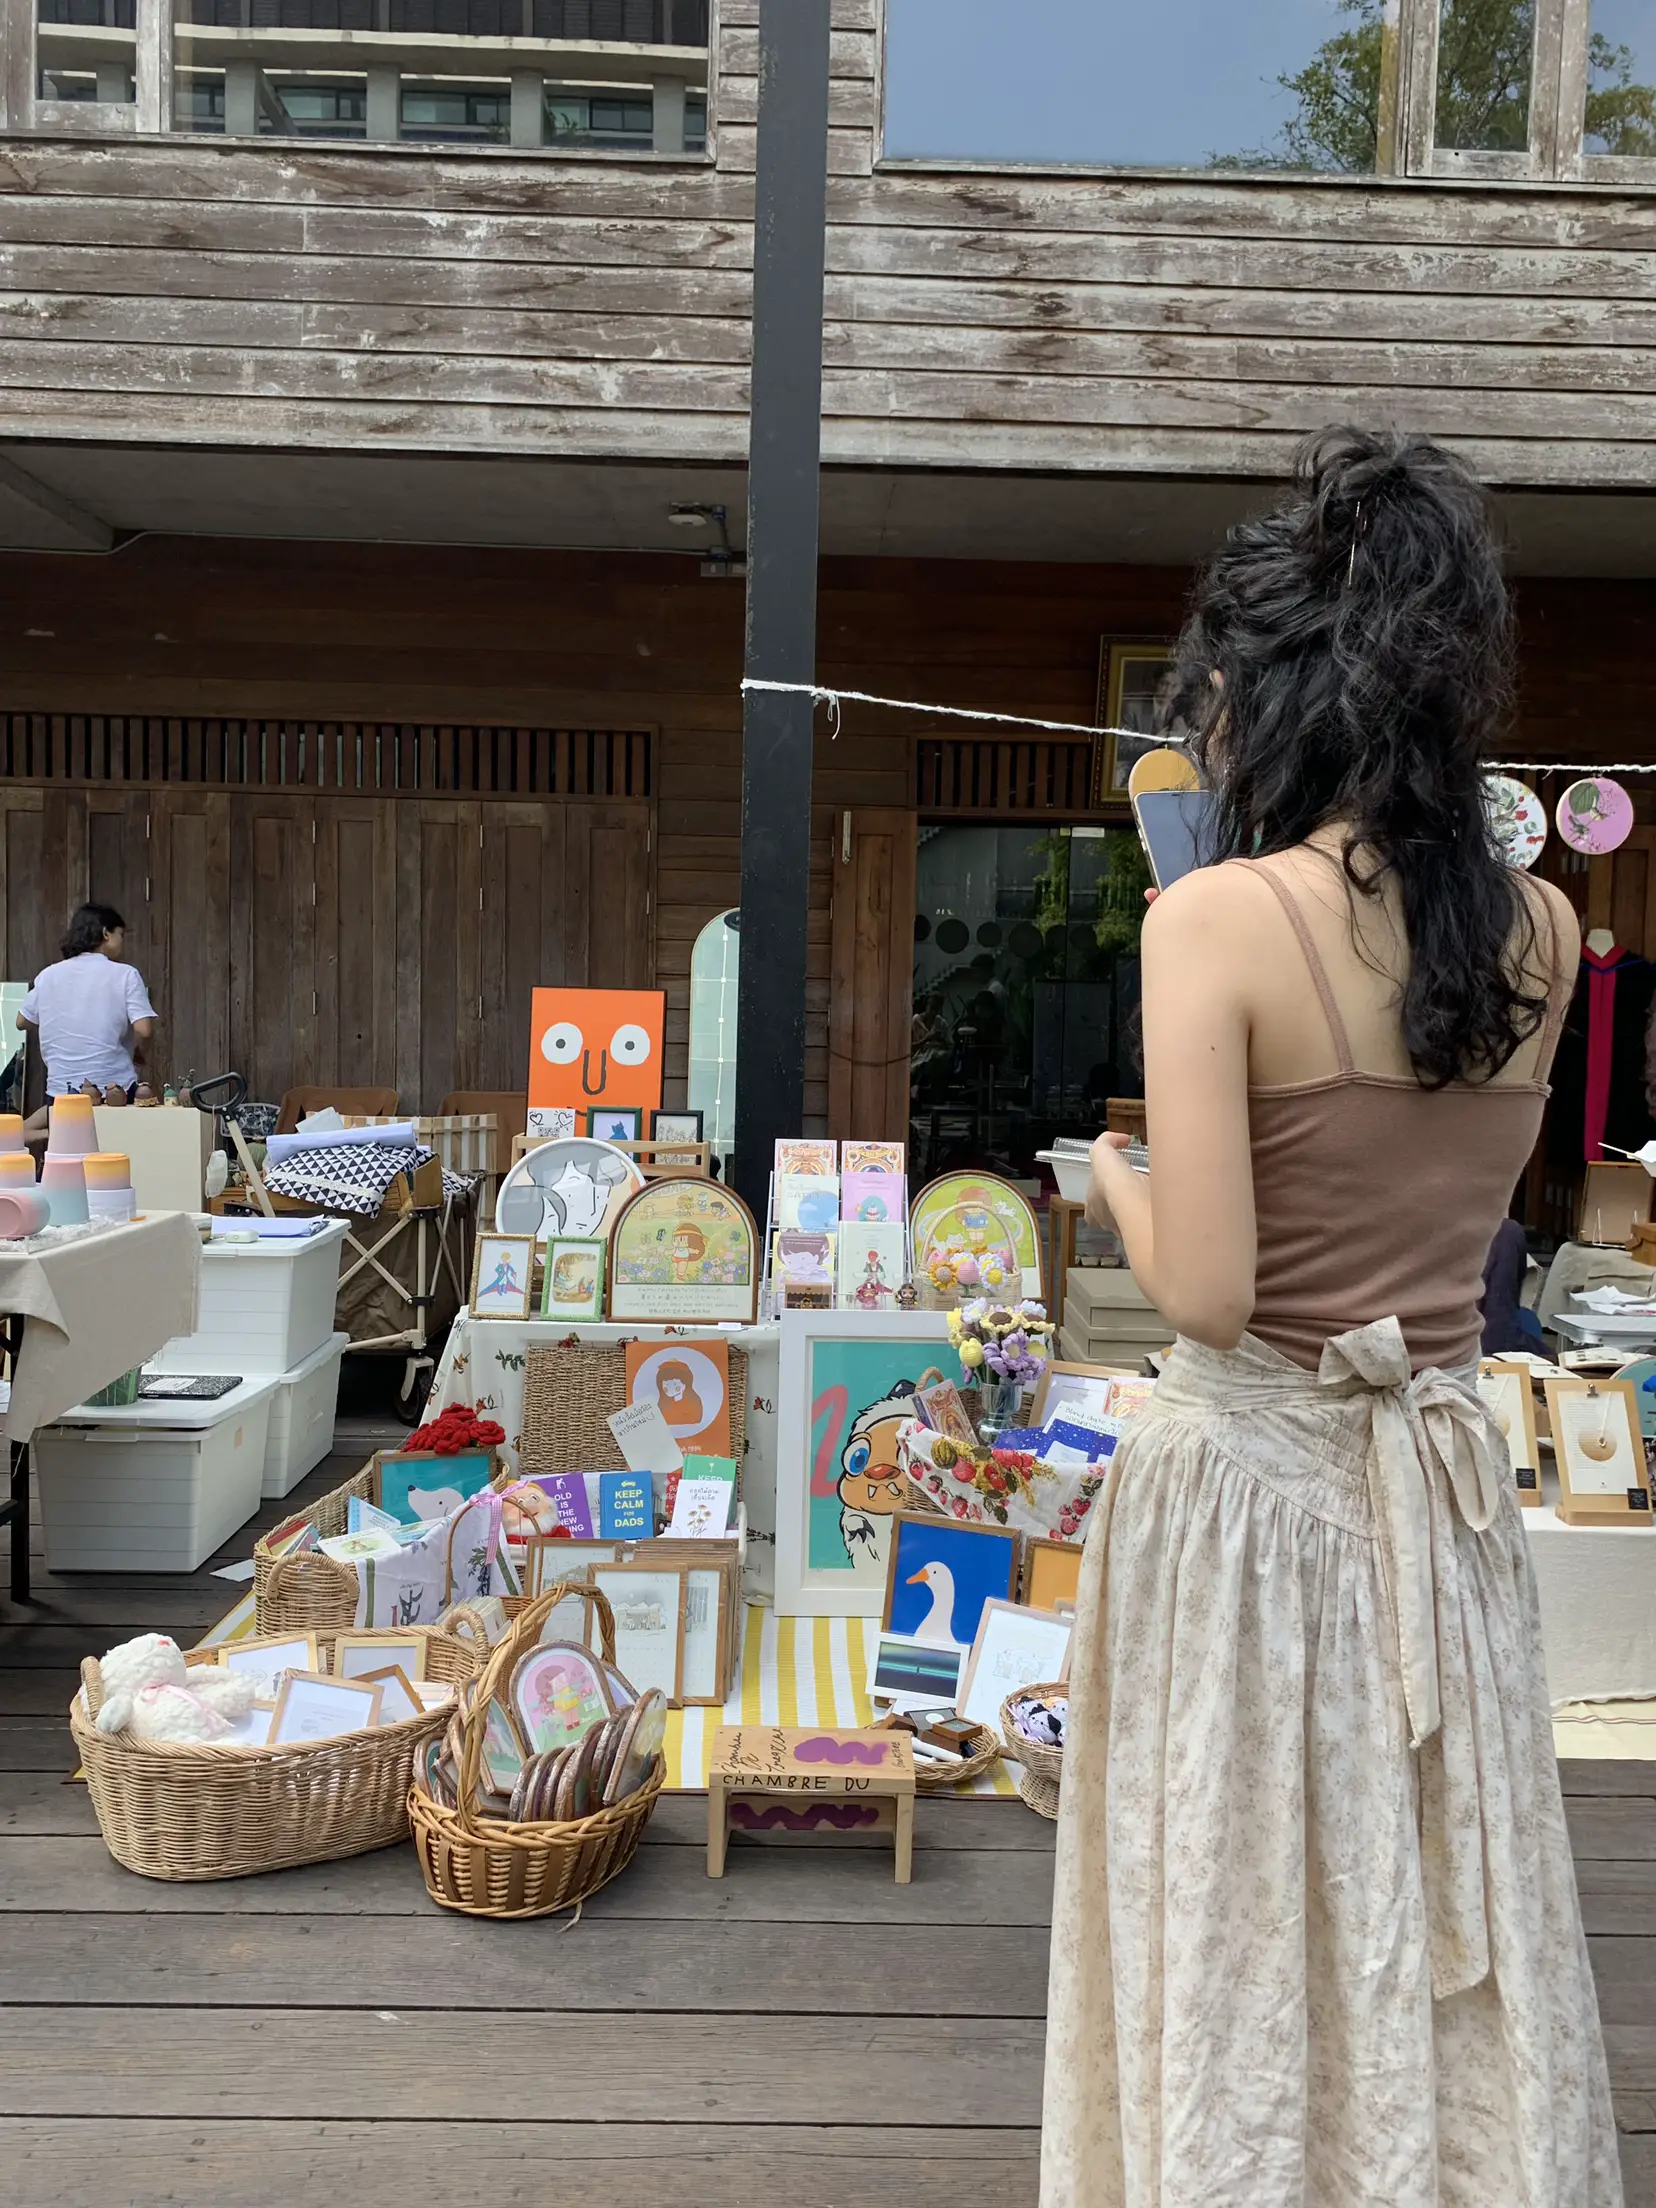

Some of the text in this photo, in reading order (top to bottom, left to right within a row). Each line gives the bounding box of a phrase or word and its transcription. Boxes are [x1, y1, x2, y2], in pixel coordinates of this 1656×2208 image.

[554, 1492, 572, 1501] OLD
[615, 1489, 643, 1499] KEEP
[560, 1501, 569, 1509] IS
[614, 1500, 644, 1510] CALM
[557, 1508, 575, 1518] THE
[614, 1517, 644, 1528] DADS
[723, 1775, 870, 1791] CHAMBRE DU
